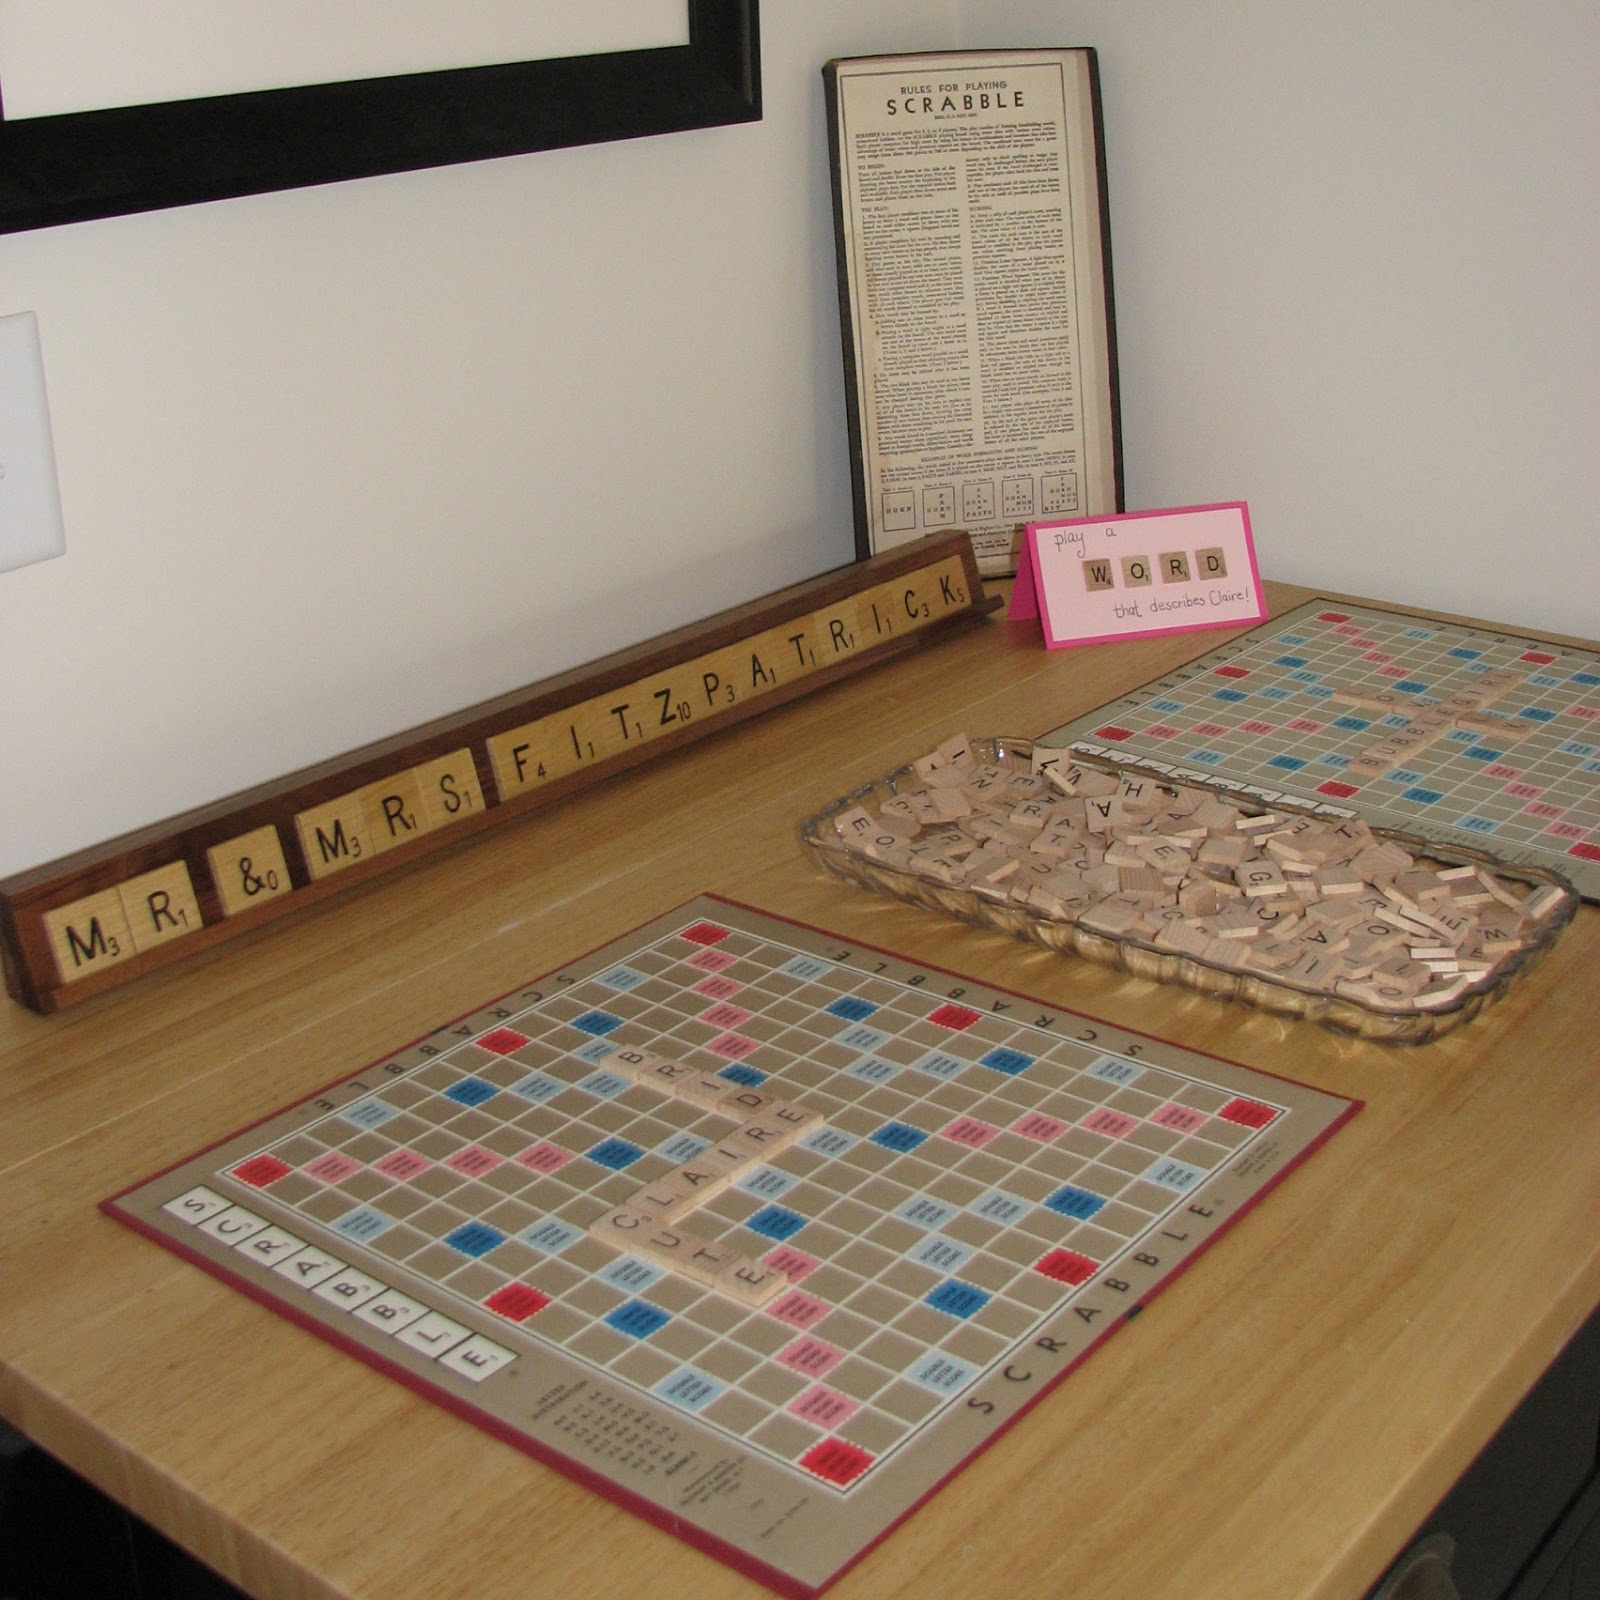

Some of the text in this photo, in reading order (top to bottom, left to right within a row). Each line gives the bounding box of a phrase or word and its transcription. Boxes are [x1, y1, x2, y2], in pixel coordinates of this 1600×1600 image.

[887, 91, 1025, 116] SCRABBLE
[901, 81, 1007, 95] RULES FOR PLAYING
[1054, 527, 1116, 558] play a
[1113, 587, 1250, 619] that describes Claire!
[831, 949, 1143, 1058] SCRABBLE
[314, 975, 576, 1111] SCRABBLE
[183, 1198, 492, 1367] SCRABBLE
[967, 1204, 1214, 1414] SCRABBLE
